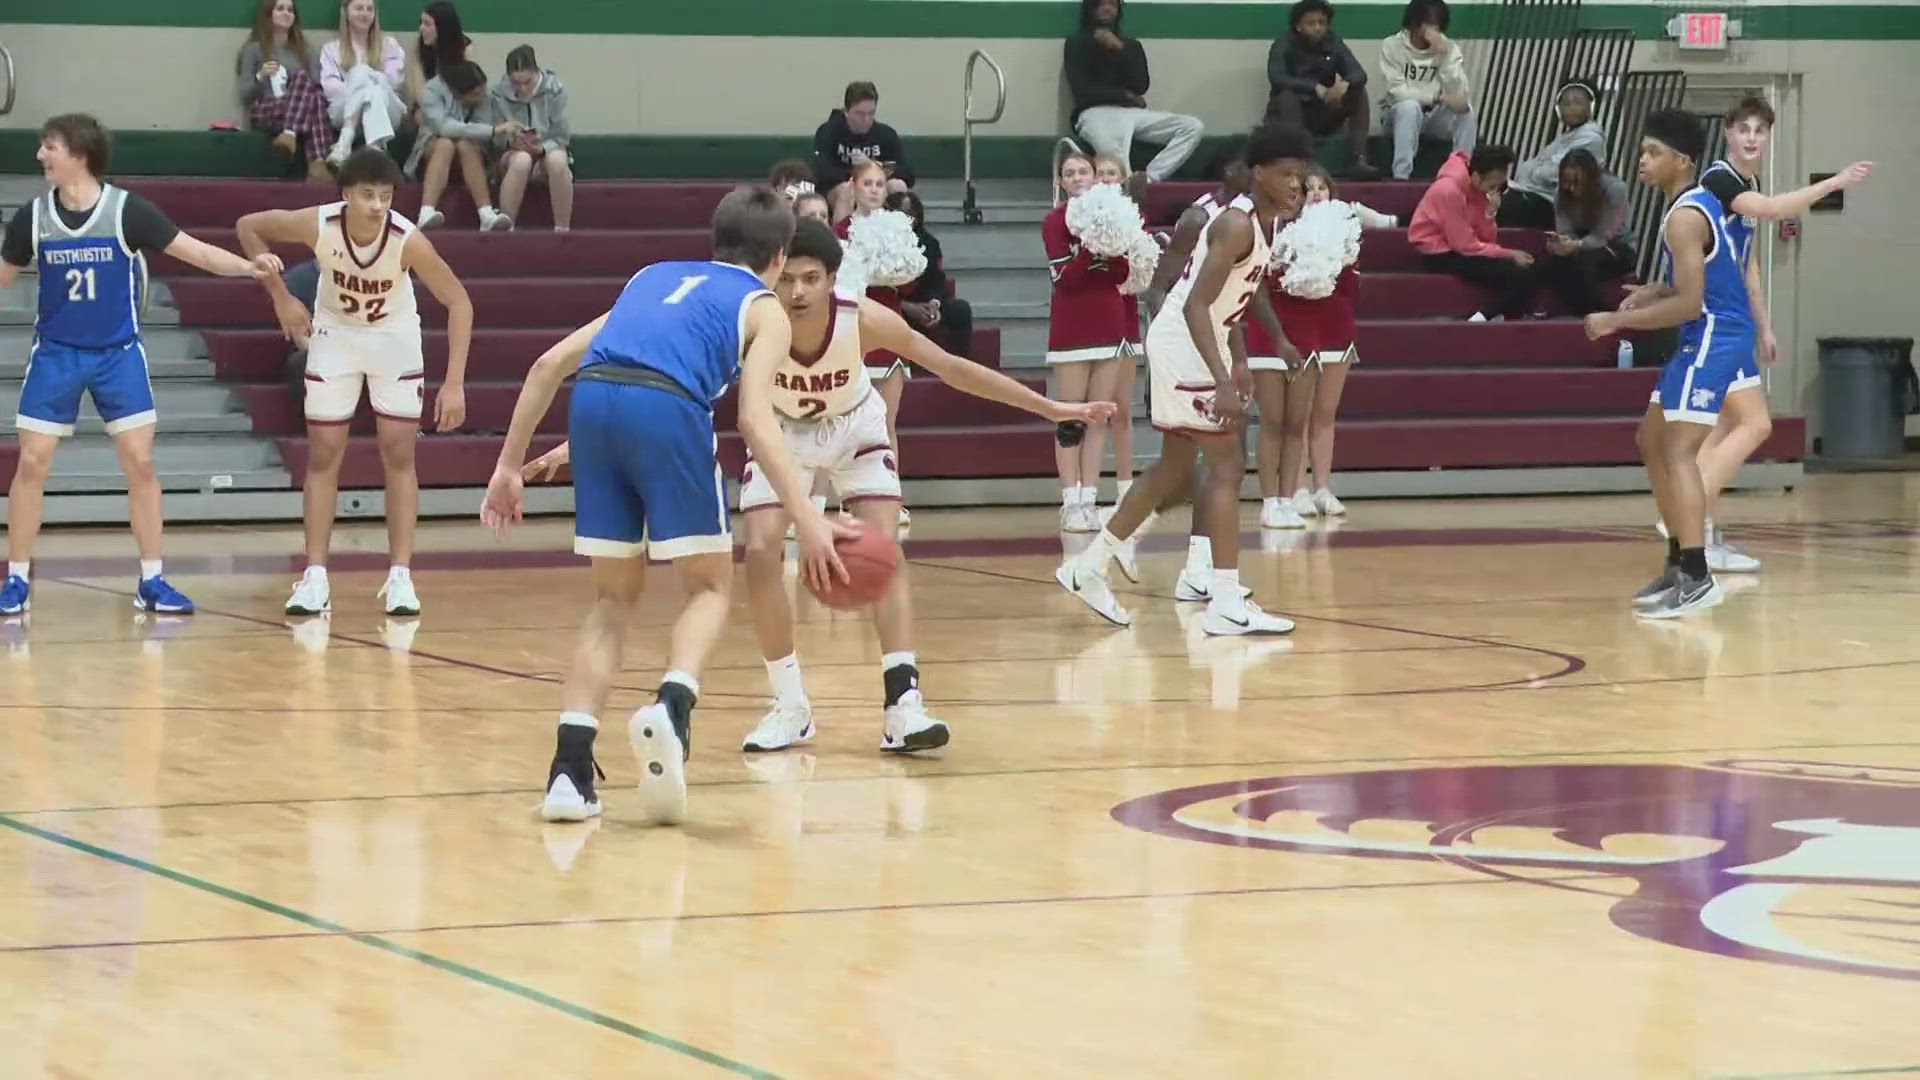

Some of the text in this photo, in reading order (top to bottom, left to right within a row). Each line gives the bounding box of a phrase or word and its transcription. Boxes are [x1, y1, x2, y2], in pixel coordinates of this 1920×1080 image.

[1687, 14, 1721, 44] EXIT
[1404, 63, 1437, 82] 1977
[65, 267, 96, 301] 21
[332, 269, 393, 294] RAMS
[663, 274, 708, 304] 1
[772, 368, 849, 392] RAMS
[798, 397, 826, 418] 2
